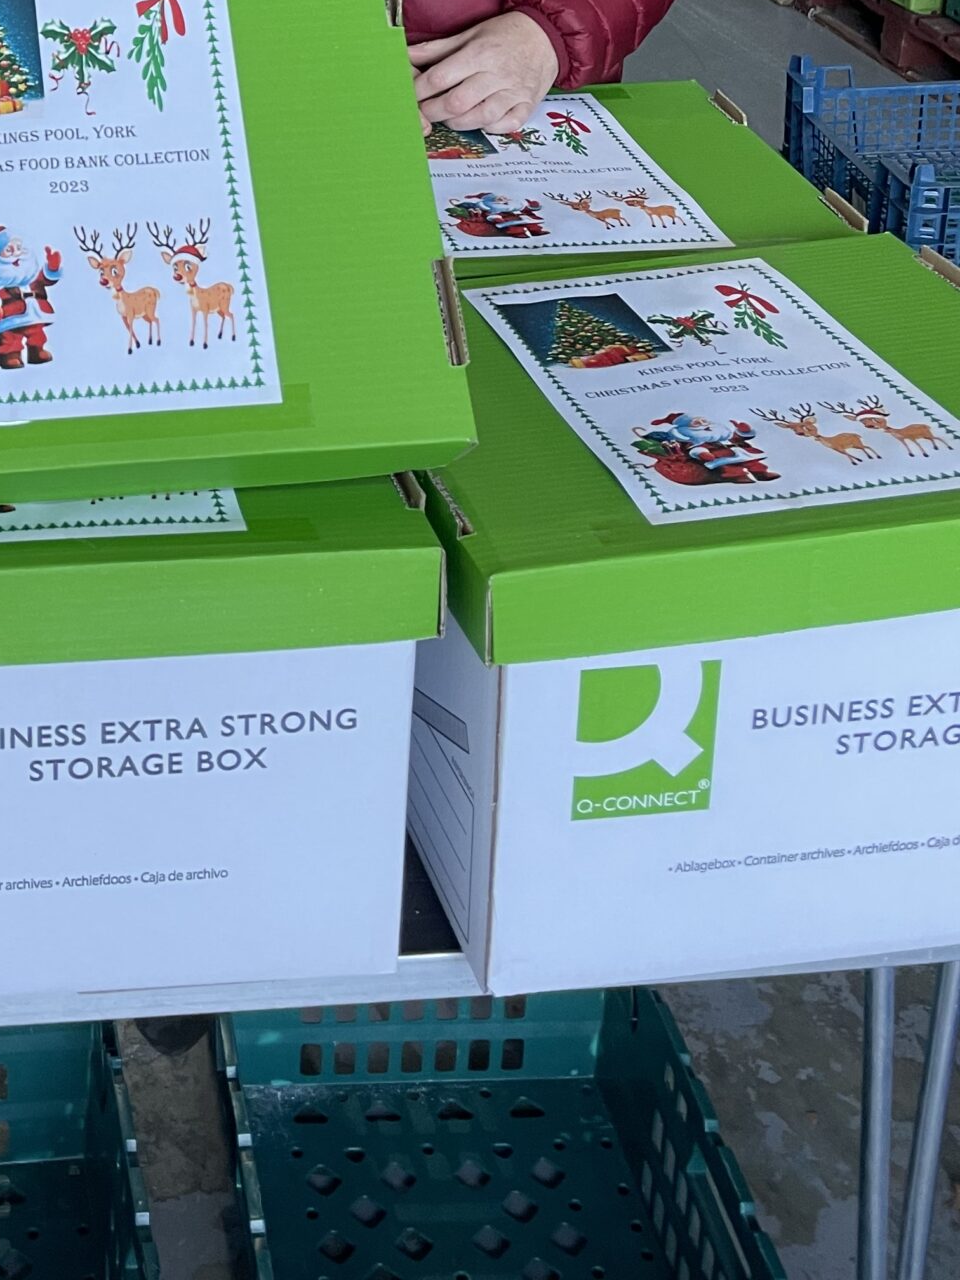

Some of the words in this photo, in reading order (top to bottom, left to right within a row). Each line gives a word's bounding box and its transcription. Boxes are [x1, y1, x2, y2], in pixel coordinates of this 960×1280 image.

[44, 128, 89, 142] POOL,
[92, 125, 138, 138] YORK
[19, 158, 60, 171] FOOD
[65, 155, 110, 169] BANK
[114, 149, 210, 167] COLLECTION
[49, 180, 90, 194] 2023
[638, 365, 685, 376] KINGS
[731, 356, 773, 365] YORK
[584, 379, 671, 399] CHRISTMAS
[674, 374, 713, 386] FOOD
[715, 370, 760, 381] BANK
[761, 361, 851, 378] COLLECTION
[709, 384, 750, 393] 2023
[751, 698, 895, 730] BUSINESS
[907, 691, 960, 717] EXT
[100, 717, 208, 744] EXTRA
[220, 708, 359, 738] STRONG
[836, 724, 960, 755] STORAG
[29, 752, 183, 782] STORAGE
[196, 747, 268, 772] BOX
[674, 858, 736, 873] Ablagebox
[744, 853, 798, 867] Container
[800, 847, 846, 862] archives
[852, 839, 919, 856] Archiefdoos
[927, 835, 951, 849] Caja
[5, 878, 53, 891] archives
[62, 873, 132, 887] Archiefdoos
[140, 871, 166, 884] Caja
[167, 870, 183, 881] de
[185, 867, 229, 880] archivo
